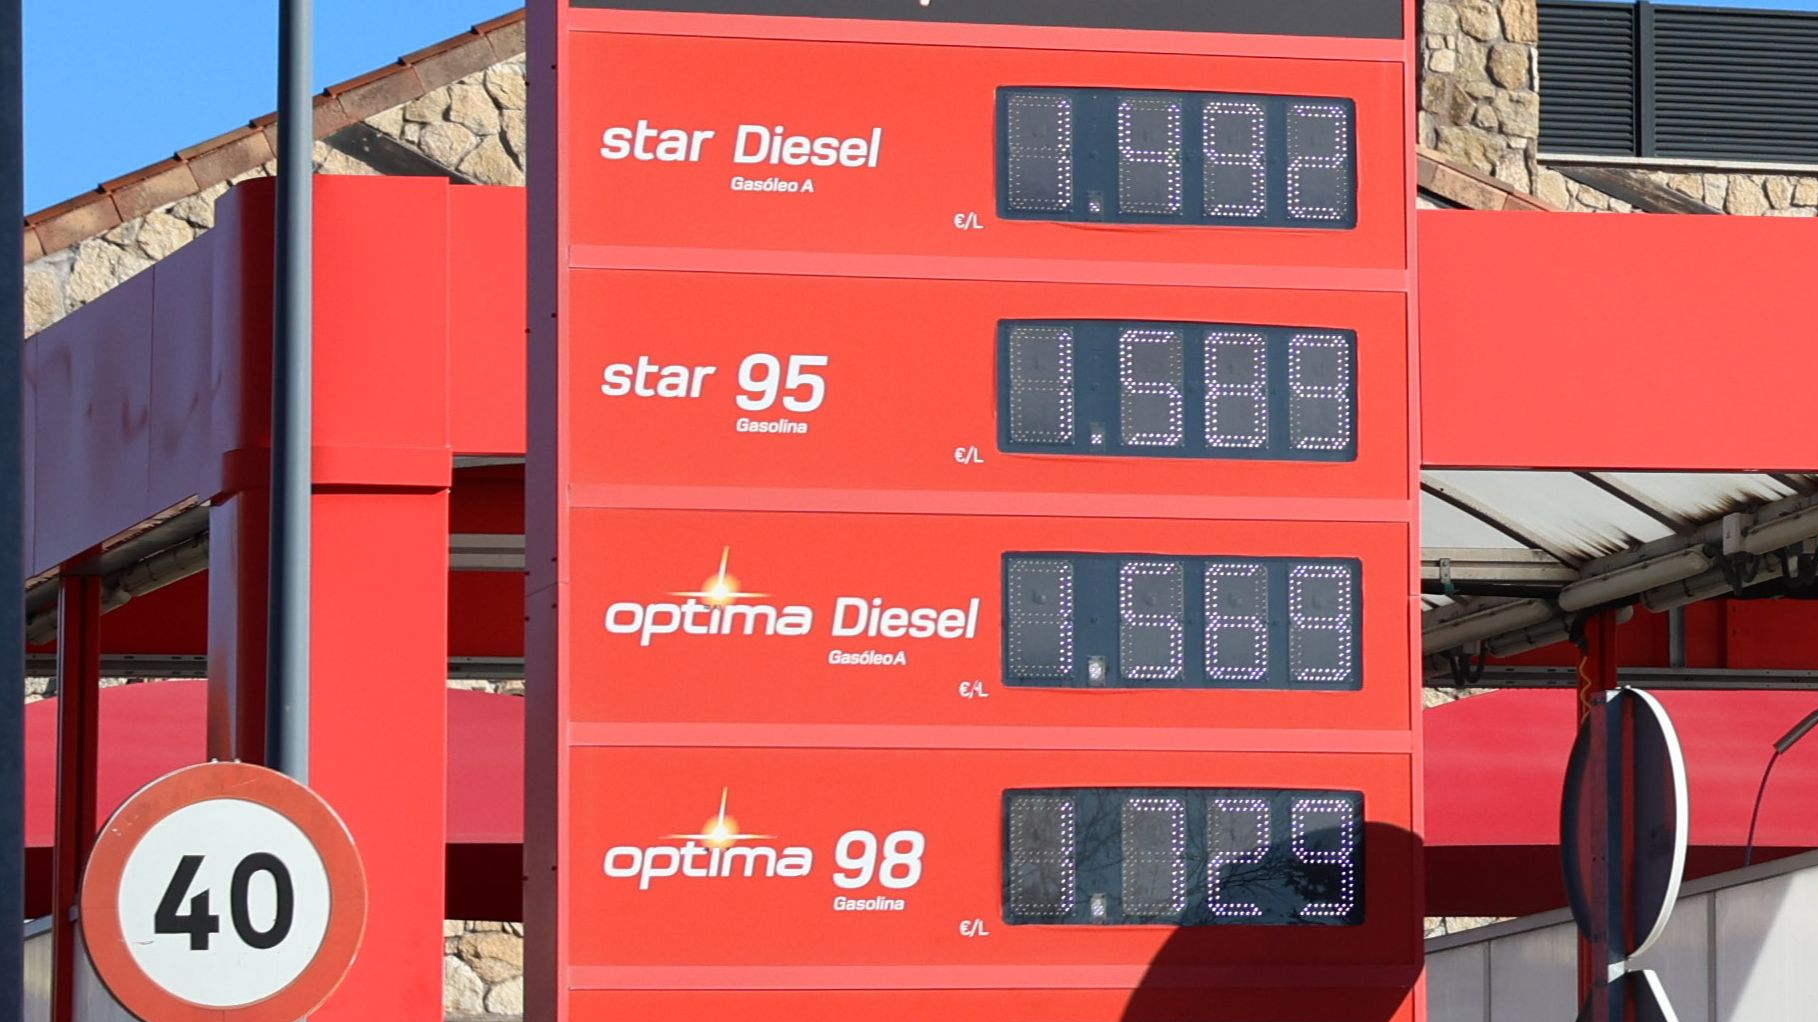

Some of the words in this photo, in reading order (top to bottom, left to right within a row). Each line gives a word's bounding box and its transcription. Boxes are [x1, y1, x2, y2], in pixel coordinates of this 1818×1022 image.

[600, 119, 716, 162] star
[733, 124, 882, 168] Diesel
[1057, 97, 1347, 220] 1.492
[730, 176, 799, 193] Gasóleo
[800, 178, 814, 193] A
[953, 211, 984, 230] €/L
[601, 355, 717, 398] star
[735, 353, 829, 413] 95
[1058, 328, 1350, 450] 1.589
[736, 417, 808, 434] Gasolina
[954, 445, 985, 465] €/L
[604, 598, 814, 647] optima
[831, 596, 980, 639] Diesel
[1059, 561, 1353, 682] 1.569
[828, 649, 893, 666] Gasóleo
[892, 650, 907, 666] A
[959, 681, 989, 699] €/L
[603, 840, 814, 891] optima
[832, 829, 925, 889] 98
[1060, 797, 1354, 918] 1.729
[154, 852, 294, 951] 40
[833, 895, 905, 911] Gasolina
[959, 918, 990, 938] €/L
